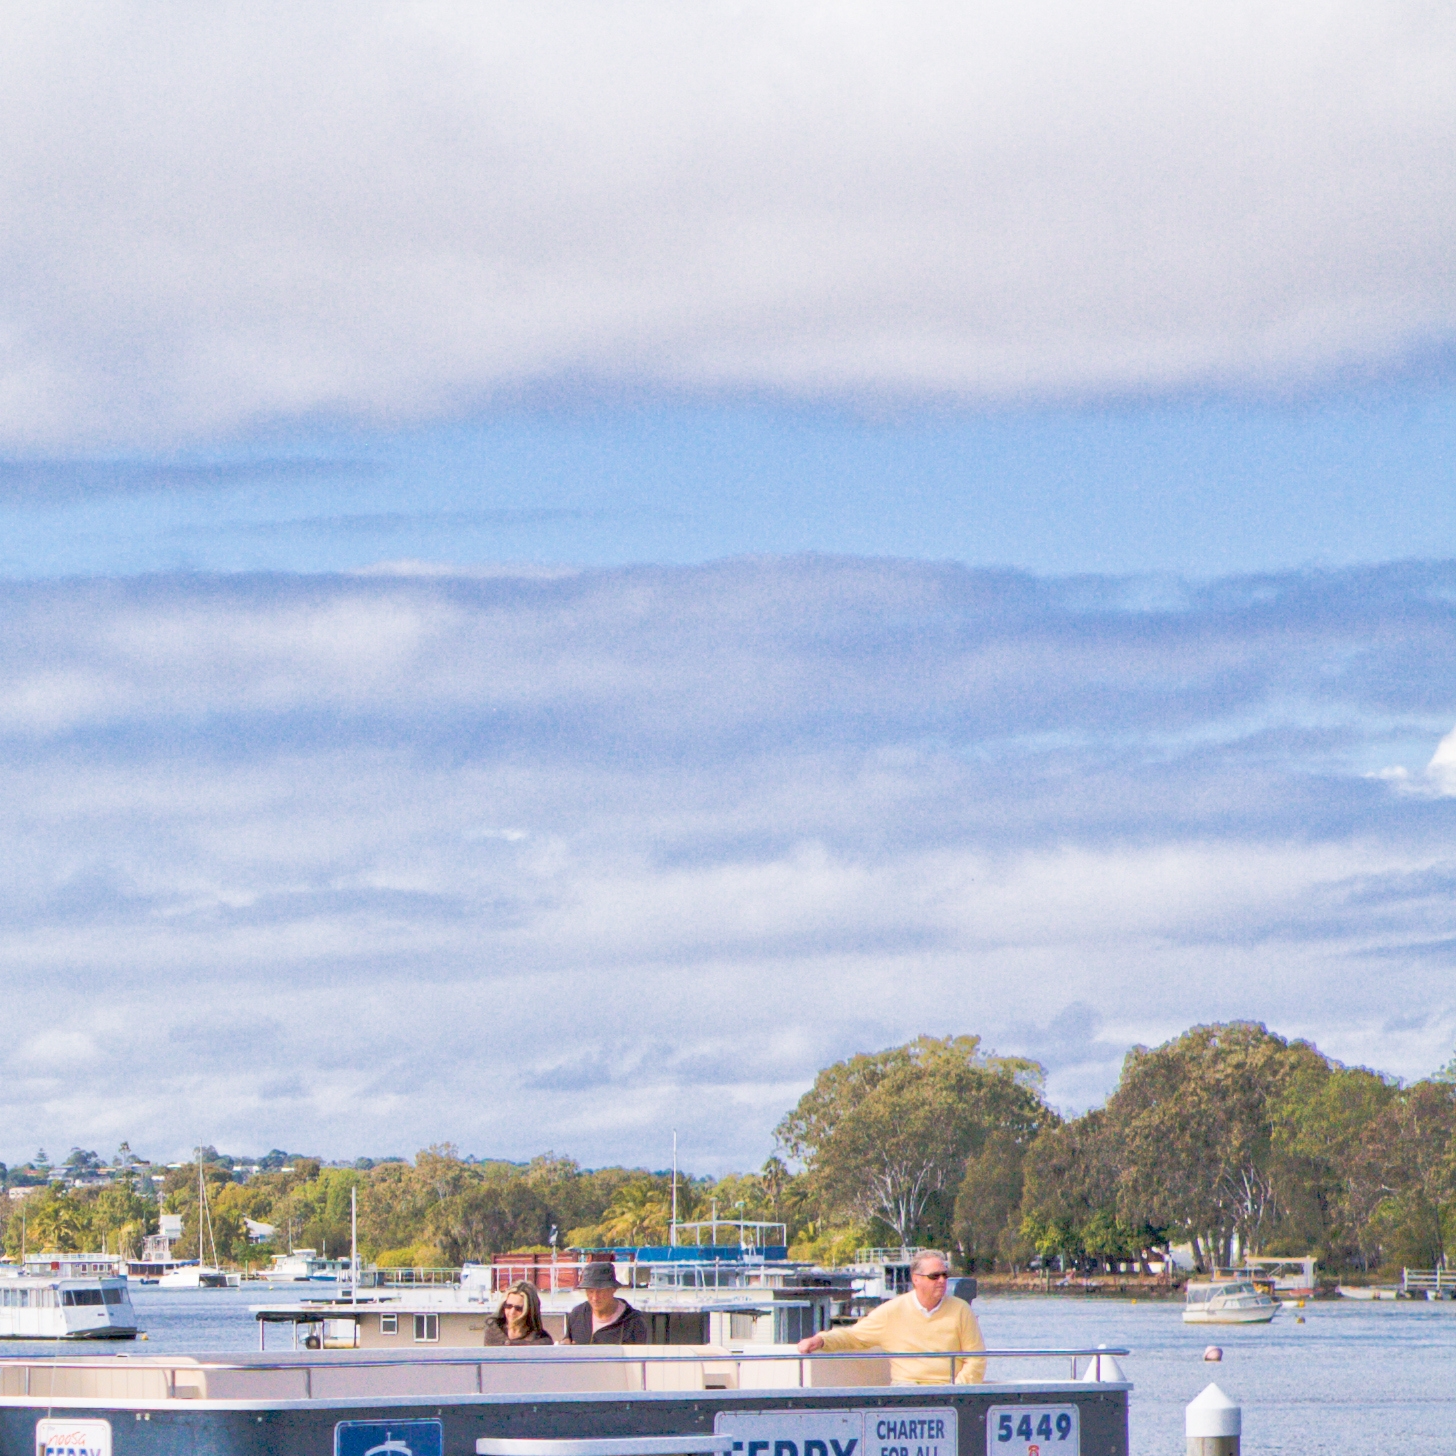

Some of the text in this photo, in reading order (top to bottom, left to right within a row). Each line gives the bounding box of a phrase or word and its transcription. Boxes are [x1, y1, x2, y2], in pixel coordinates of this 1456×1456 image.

[876, 1419, 945, 1440] CHARTER
[997, 1413, 1072, 1442] 5449
[48, 1431, 86, 1446] noosa
